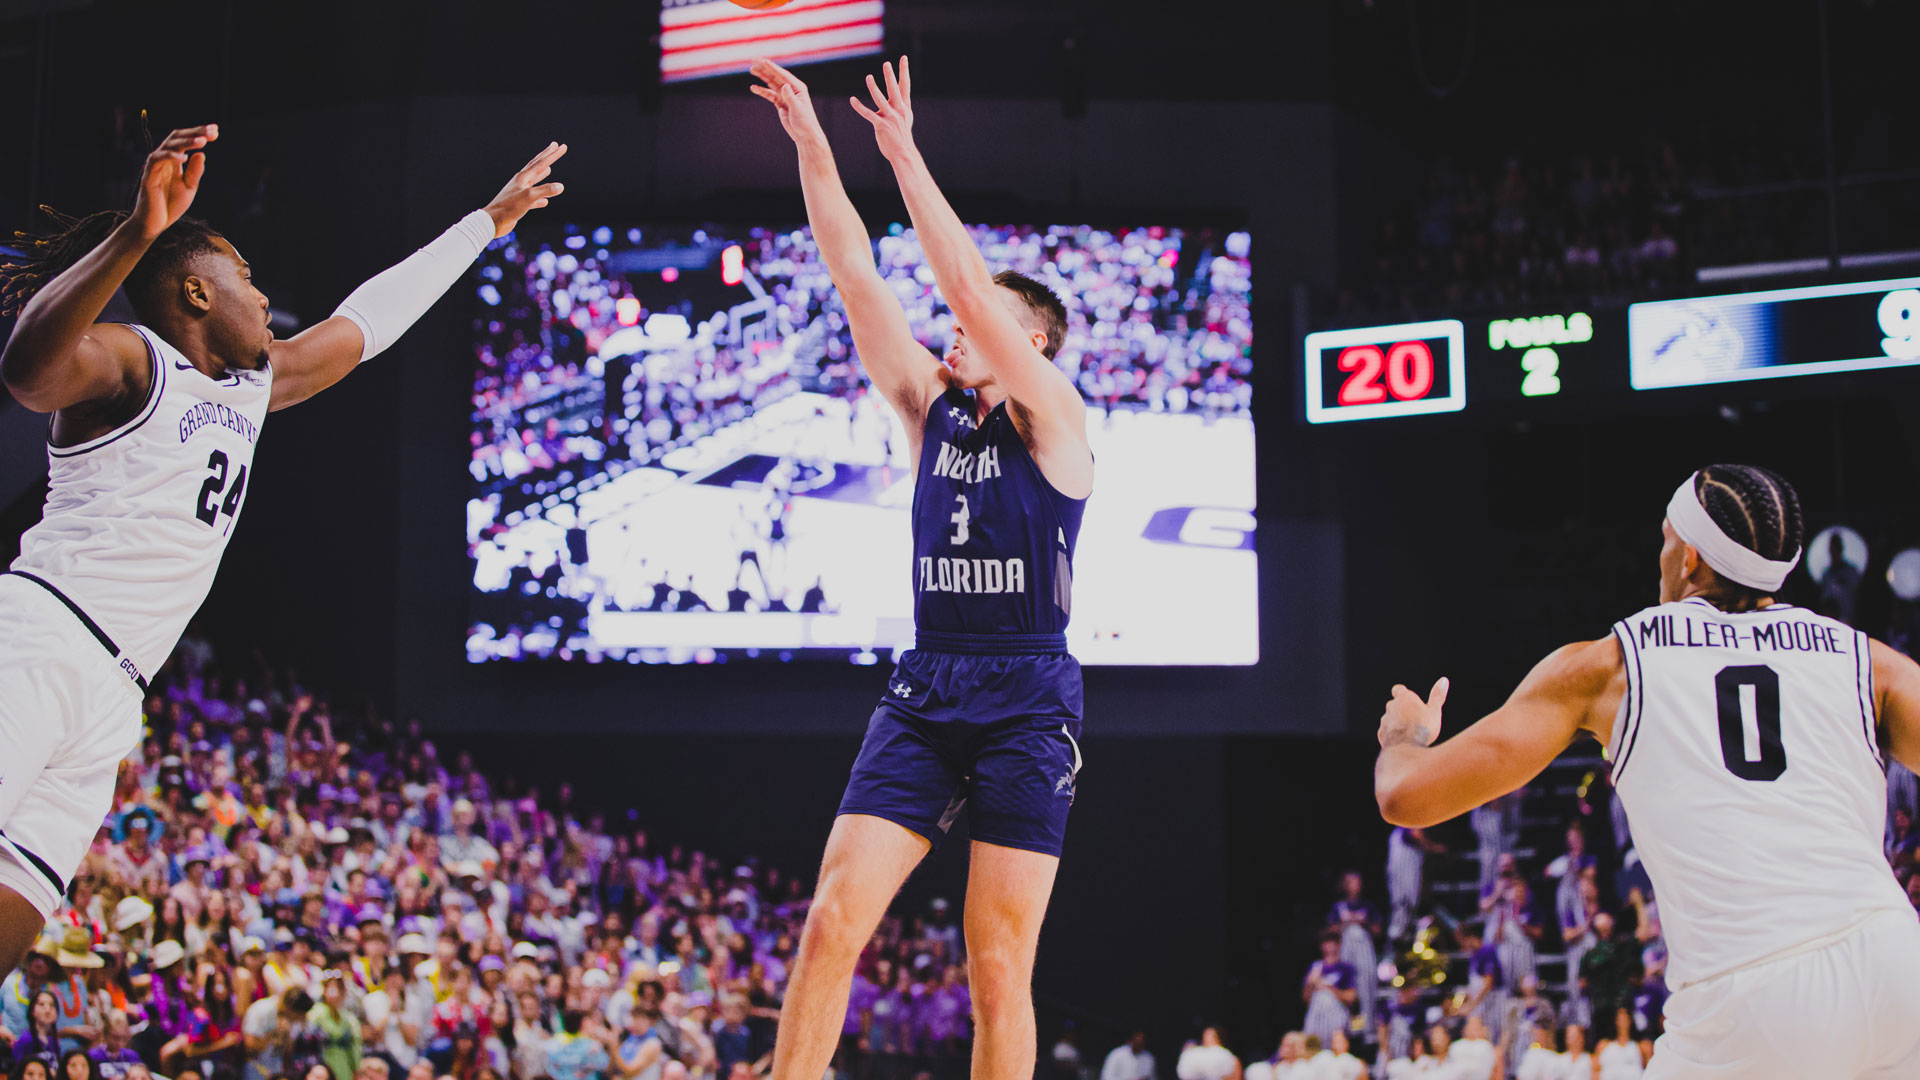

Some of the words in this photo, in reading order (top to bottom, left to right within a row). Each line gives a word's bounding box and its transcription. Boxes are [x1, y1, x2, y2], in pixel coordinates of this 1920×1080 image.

[1337, 340, 1434, 406] 20
[1521, 347, 1560, 396] 2
[179, 401, 217, 443] GRAND
[196, 449, 247, 537] 24
[950, 494, 970, 545] 3
[919, 556, 1025, 593] FLORIDA
[1640, 615, 1847, 654] MILLER-MOORE
[120, 658, 138, 680] GCU
[1715, 665, 1787, 781] 0
